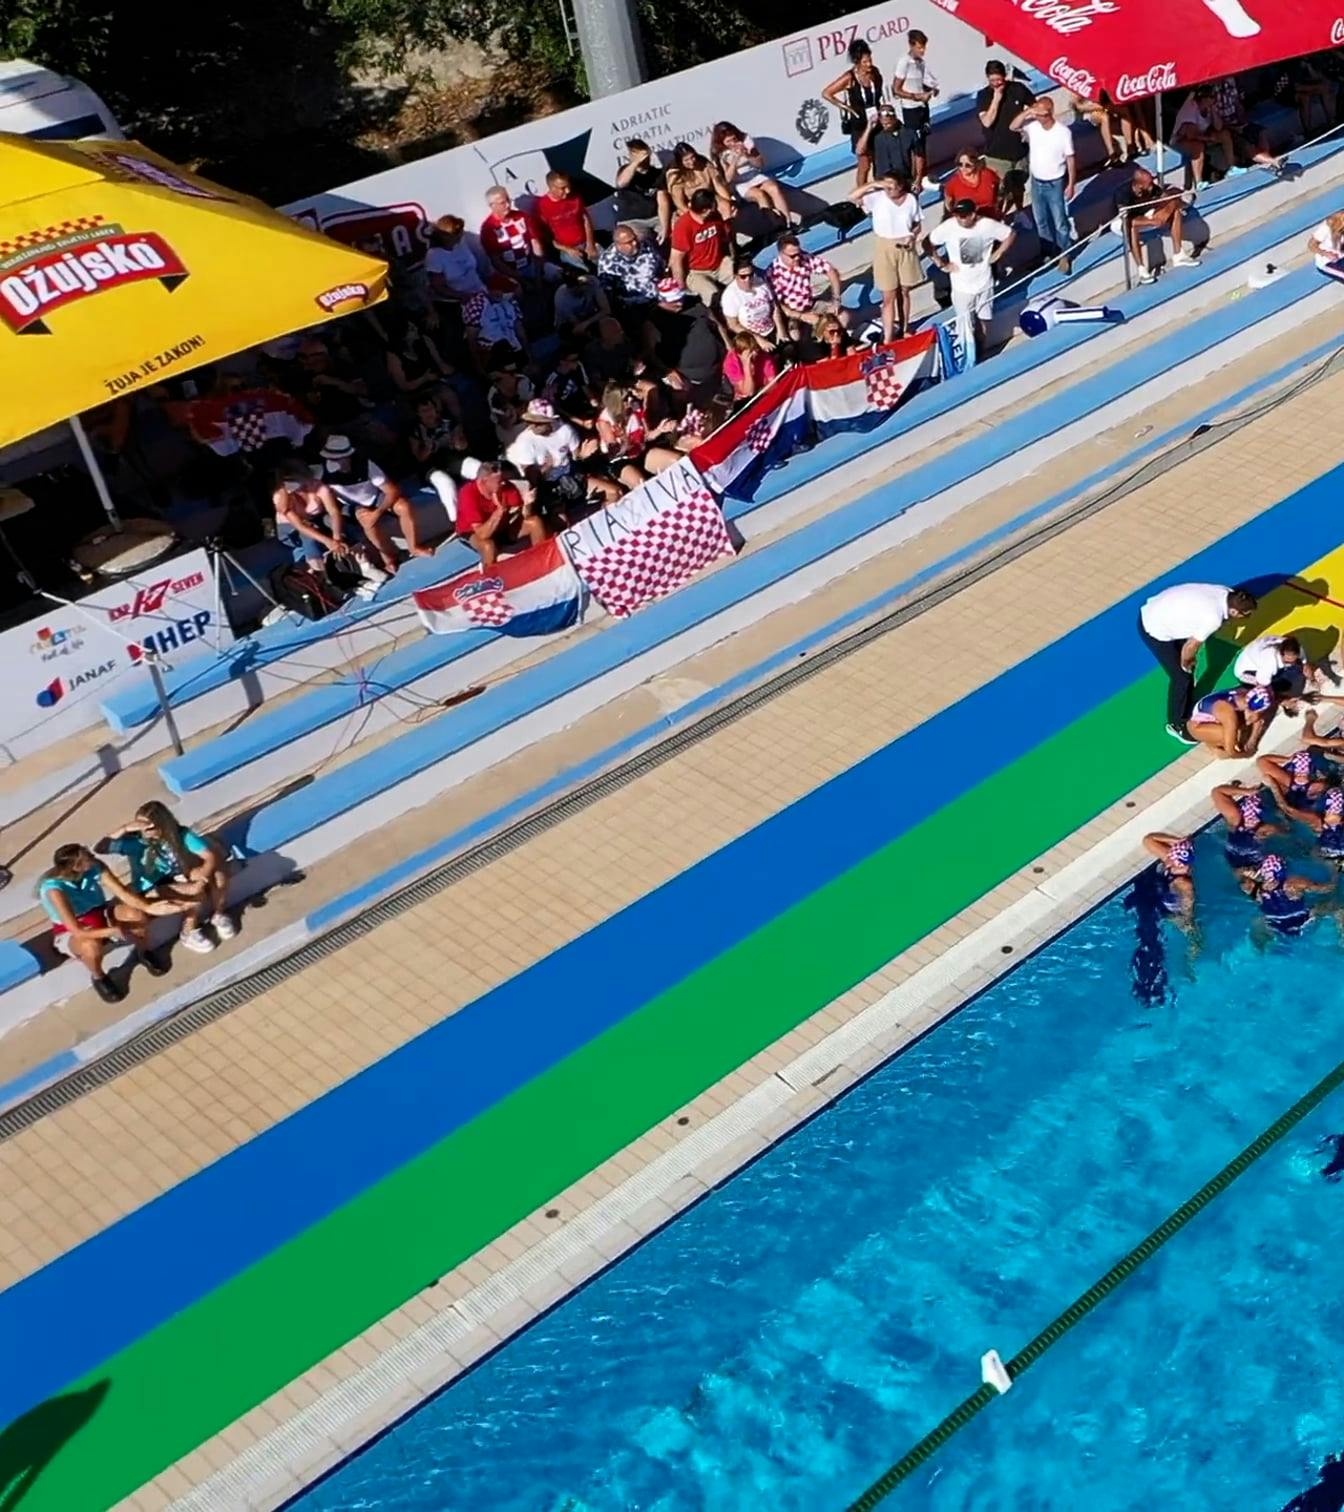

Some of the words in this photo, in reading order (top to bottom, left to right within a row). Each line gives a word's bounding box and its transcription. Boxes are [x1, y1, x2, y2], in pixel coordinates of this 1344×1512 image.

[817, 24, 859, 61] PBZ
[866, 16, 910, 43] CARD
[610, 103, 672, 135] ADRIATIC
[0, 240, 165, 316] Ožujsko
[104, 373, 140, 396] ŽUJA
[142, 361, 158, 377] JE
[159, 334, 206, 368] ZAKON!
[157, 610, 211, 654] HEP
[68, 659, 118, 691] JANAF
